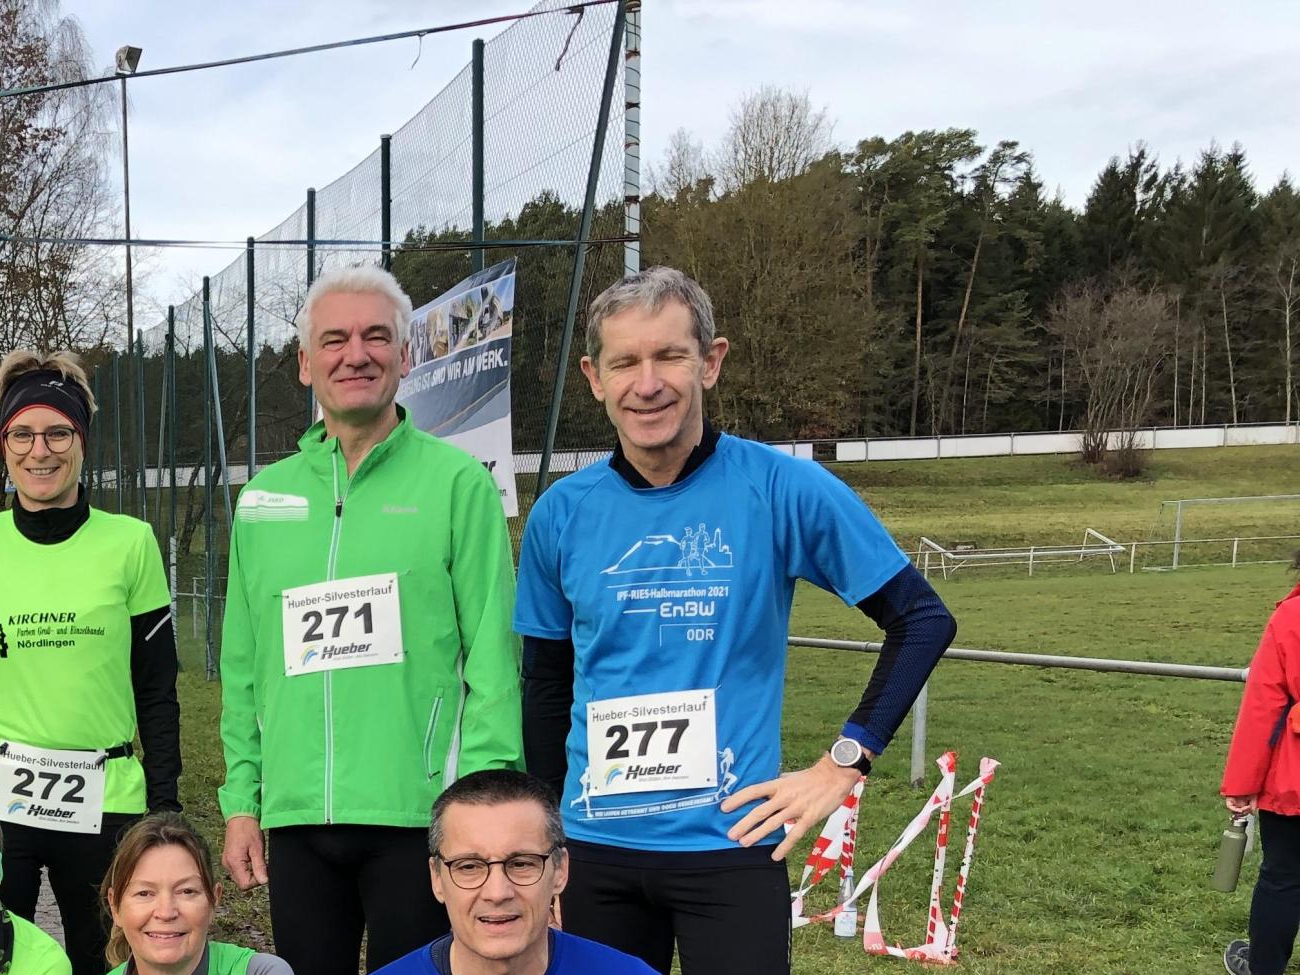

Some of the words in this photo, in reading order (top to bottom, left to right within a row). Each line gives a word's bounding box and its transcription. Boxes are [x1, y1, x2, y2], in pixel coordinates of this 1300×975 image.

[462, 356, 476, 377] AM
[288, 584, 393, 609] Hueber-Silvesterlauf
[708, 586, 729, 597] 2021
[660, 601, 715, 618] EnBW
[8, 612, 77, 626] KIRCHNER
[301, 602, 373, 643] 271
[686, 628, 715, 641] ODR
[17, 639, 76, 649] Nördlingen
[321, 642, 372, 660] Hueber
[592, 701, 707, 723] Hueber-Silvesterlauf
[605, 718, 690, 761] 277
[625, 763, 682, 780] Hueber
[11, 767, 86, 804] 272
[27, 804, 76, 819] Hueber
